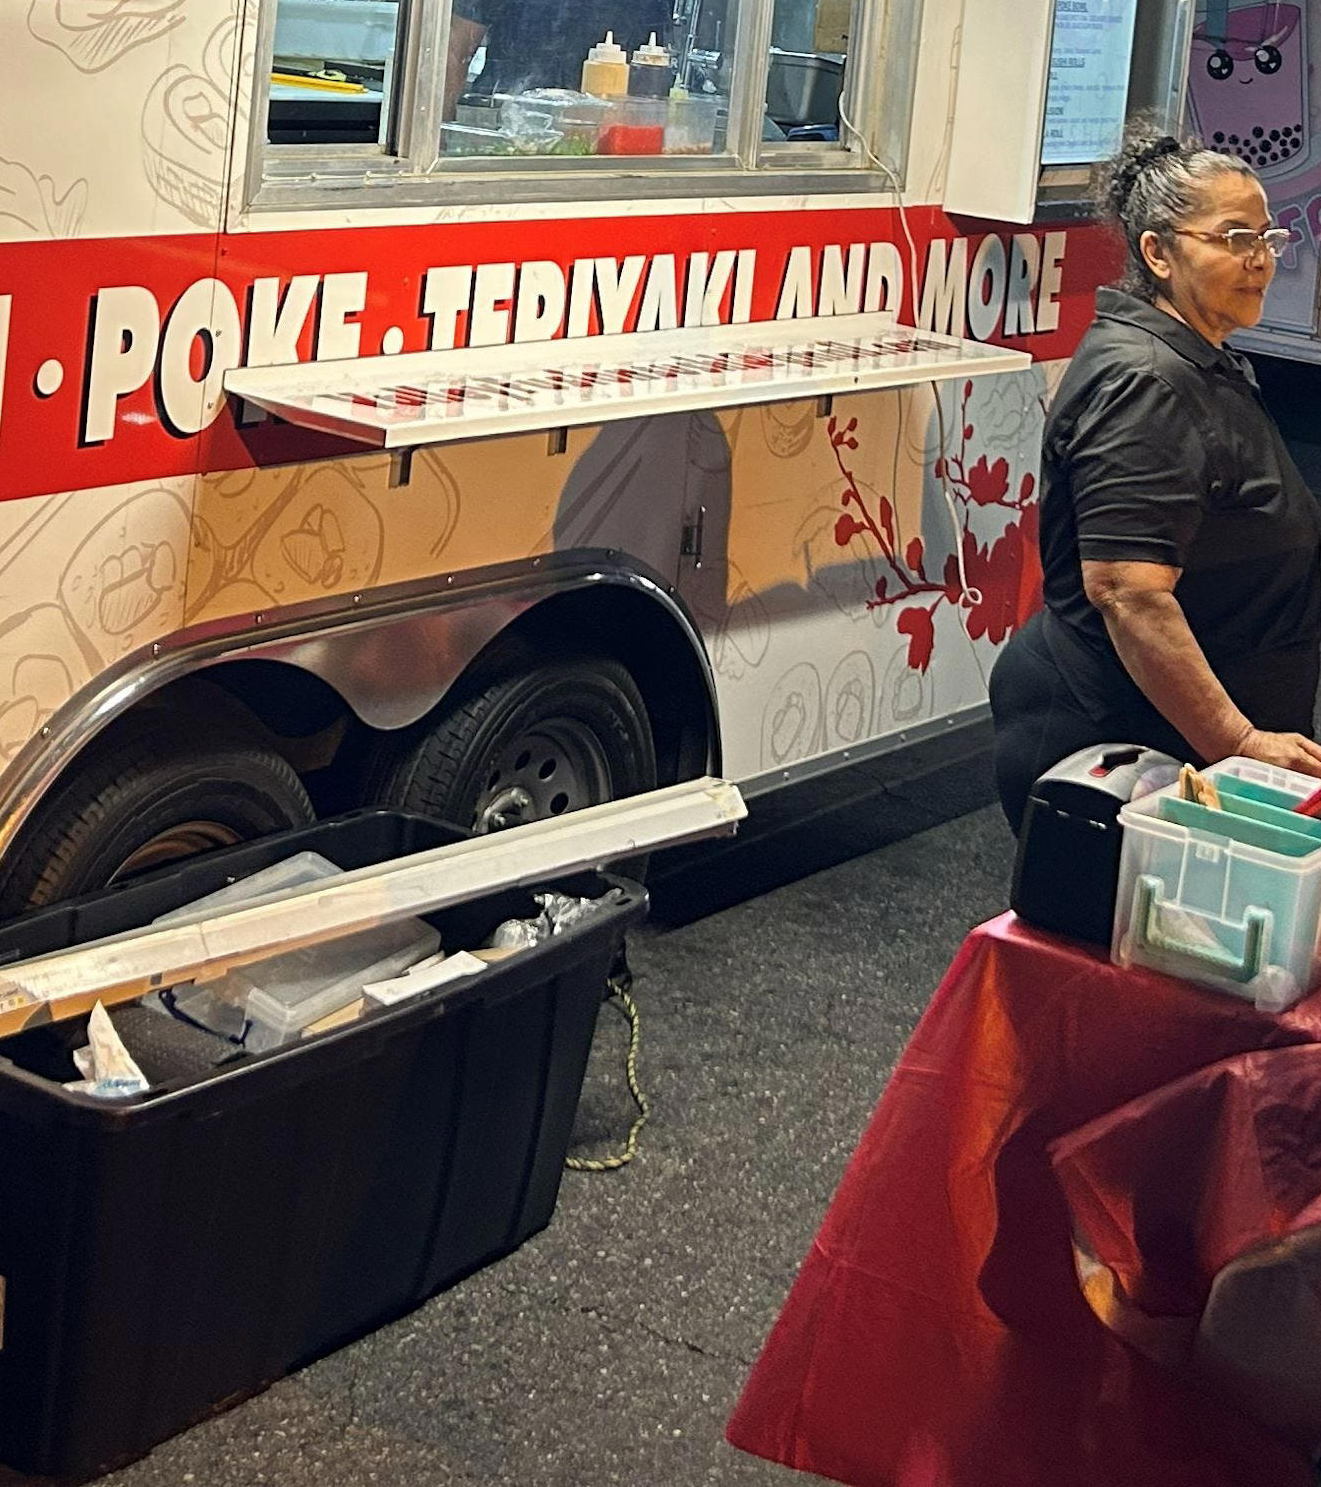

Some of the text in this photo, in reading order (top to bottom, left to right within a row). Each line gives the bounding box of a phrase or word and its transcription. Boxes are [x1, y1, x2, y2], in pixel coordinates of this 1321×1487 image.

[78, 272, 367, 447] POKE
[770, 240, 904, 324] AND
[916, 231, 1068, 343] MORE
